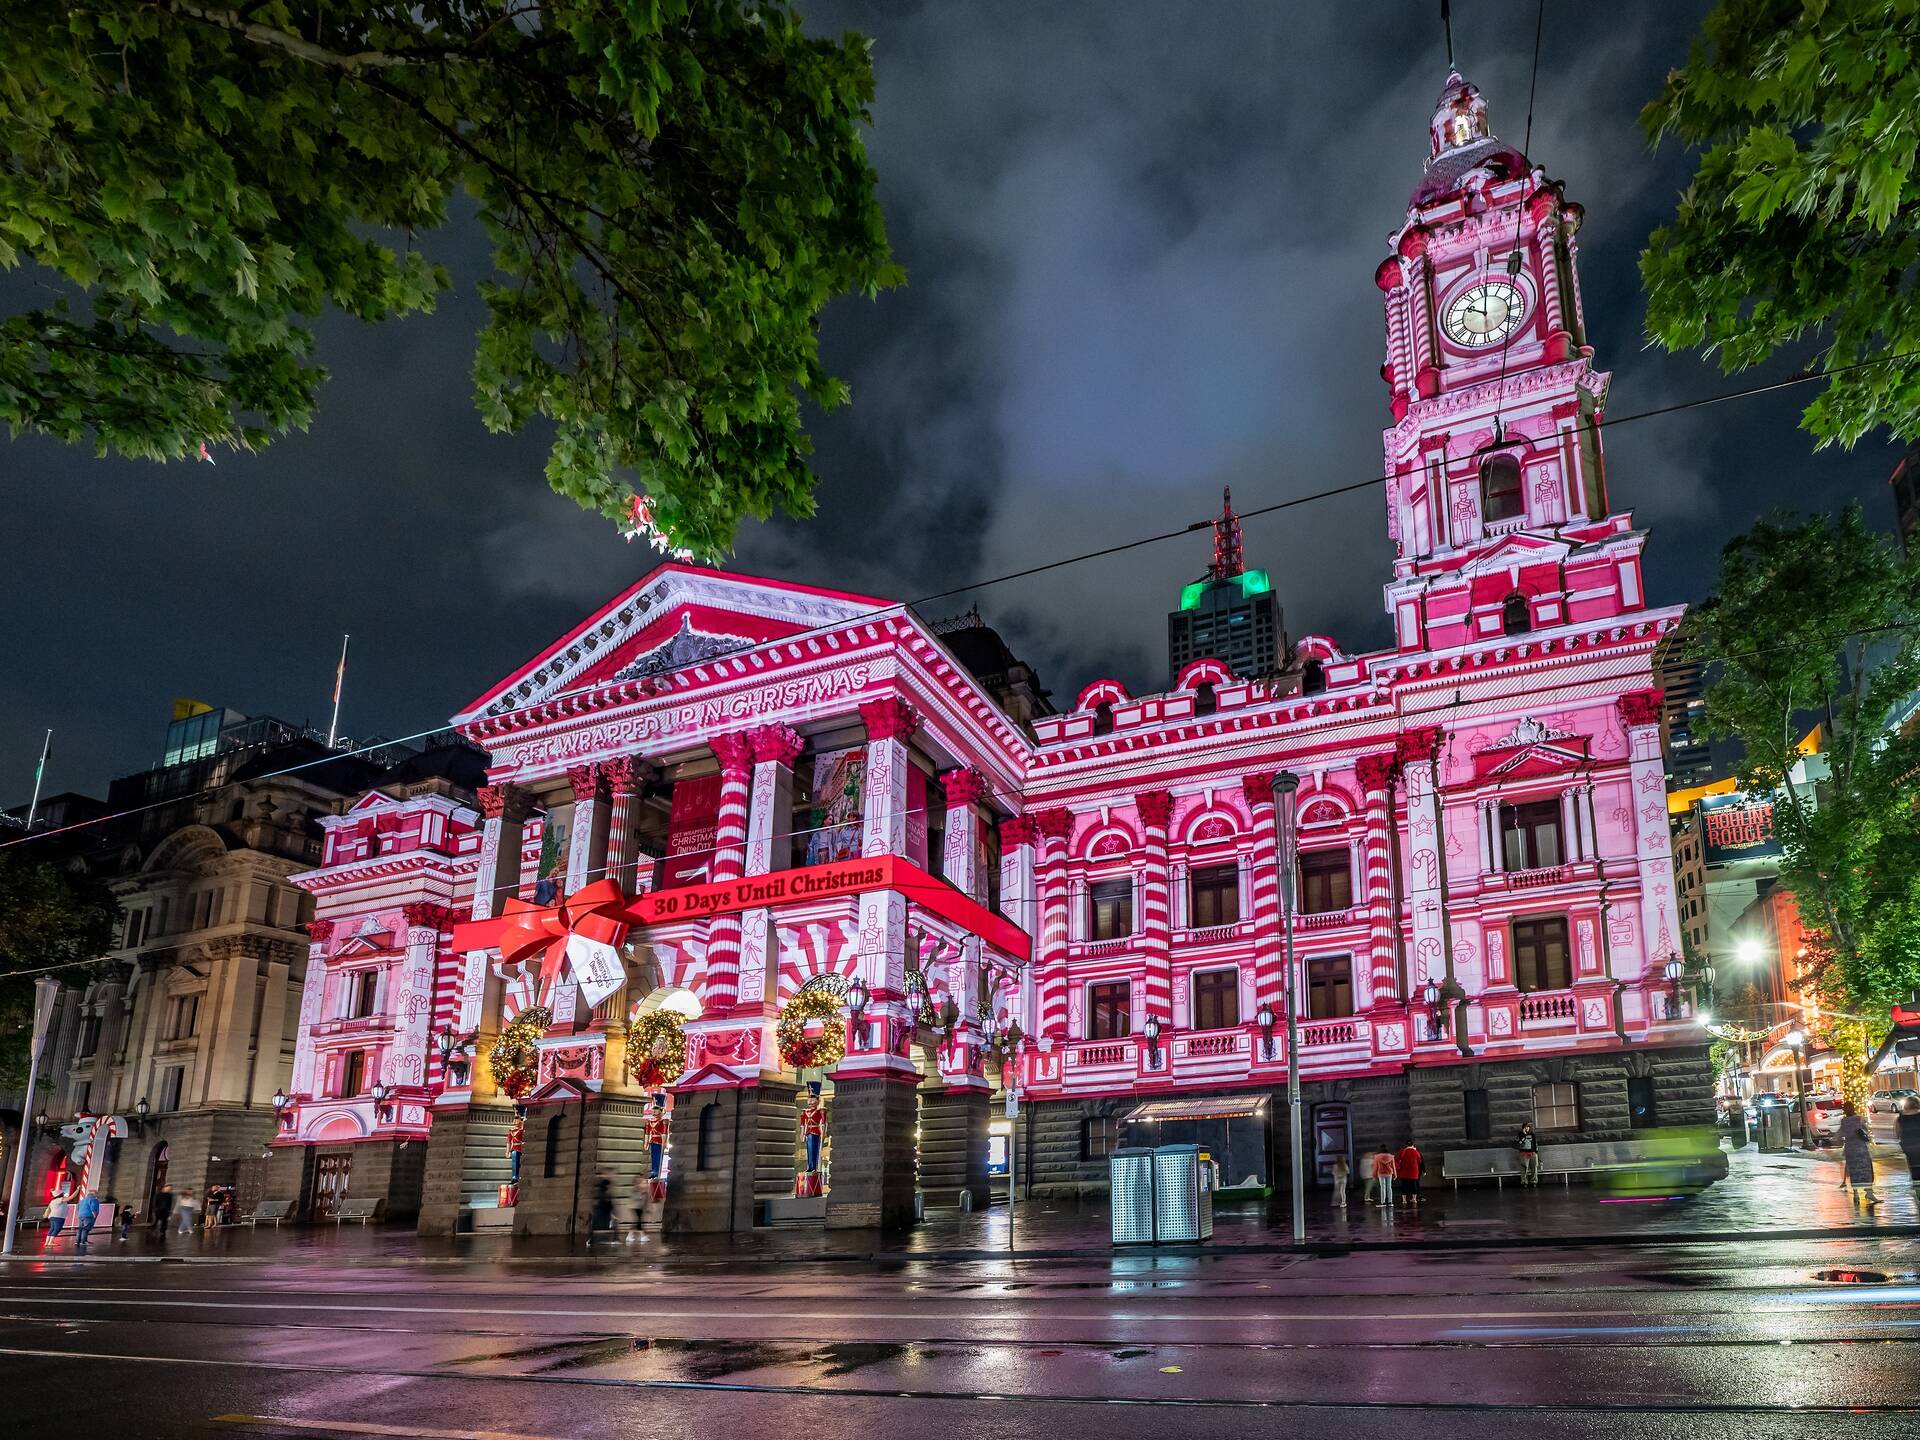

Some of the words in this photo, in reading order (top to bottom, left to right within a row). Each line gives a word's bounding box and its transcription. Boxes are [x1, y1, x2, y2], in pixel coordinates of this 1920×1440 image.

[513, 738, 553, 765] GET
[555, 716, 661, 759] WRAPPED
[660, 707, 697, 734] UP
[699, 699, 724, 727] IN
[729, 665, 870, 718] CHRISTMAS
[1706, 808, 1765, 832] MOULIN
[654, 896, 678, 915] 30
[684, 891, 731, 912] Days
[736, 878, 786, 903] Until
[790, 867, 884, 895] Christmas
